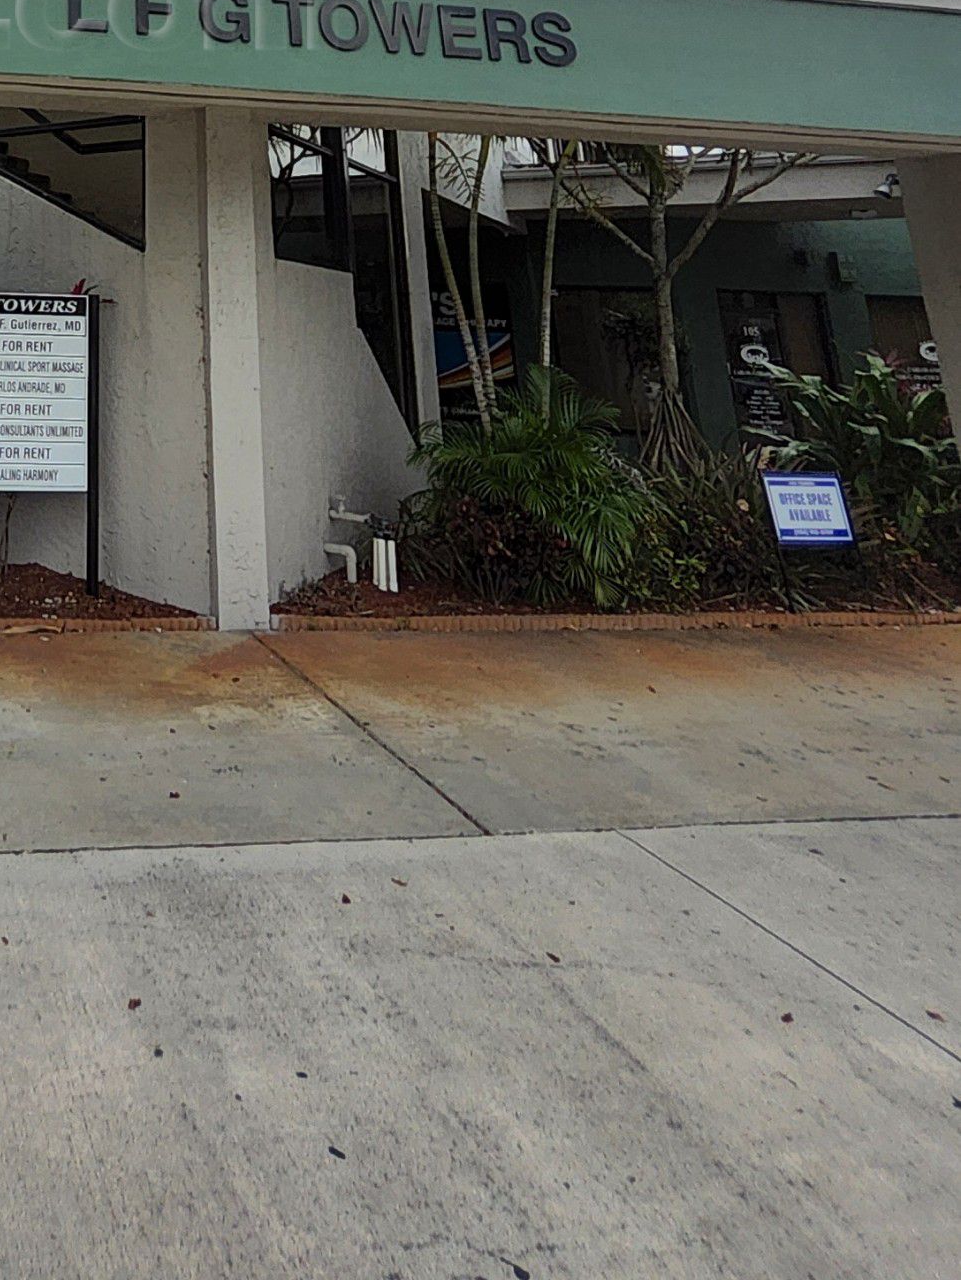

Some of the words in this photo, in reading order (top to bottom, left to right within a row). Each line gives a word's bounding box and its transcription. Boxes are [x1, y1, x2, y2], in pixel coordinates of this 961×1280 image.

[0, 319, 7, 329] F.
[10, 319, 61, 332] Gutierrez,
[65, 321, 81, 331] MD
[2, 340, 23, 352] FOR
[26, 341, 54, 352] RENT
[27, 361, 50, 373] SPORT
[52, 362, 84, 374] MASSAGE
[54, 383, 66, 393] MD
[0, 404, 21, 415] FOR
[24, 404, 53, 416] RENT
[45, 426, 84, 438] UNLIMITED
[0, 447, 20, 459] FOR
[23, 448, 52, 459] RENT
[23, 470, 59, 481] HARMONY
[779, 493, 807, 506] OFFICE
[807, 493, 833, 506] SPACE
